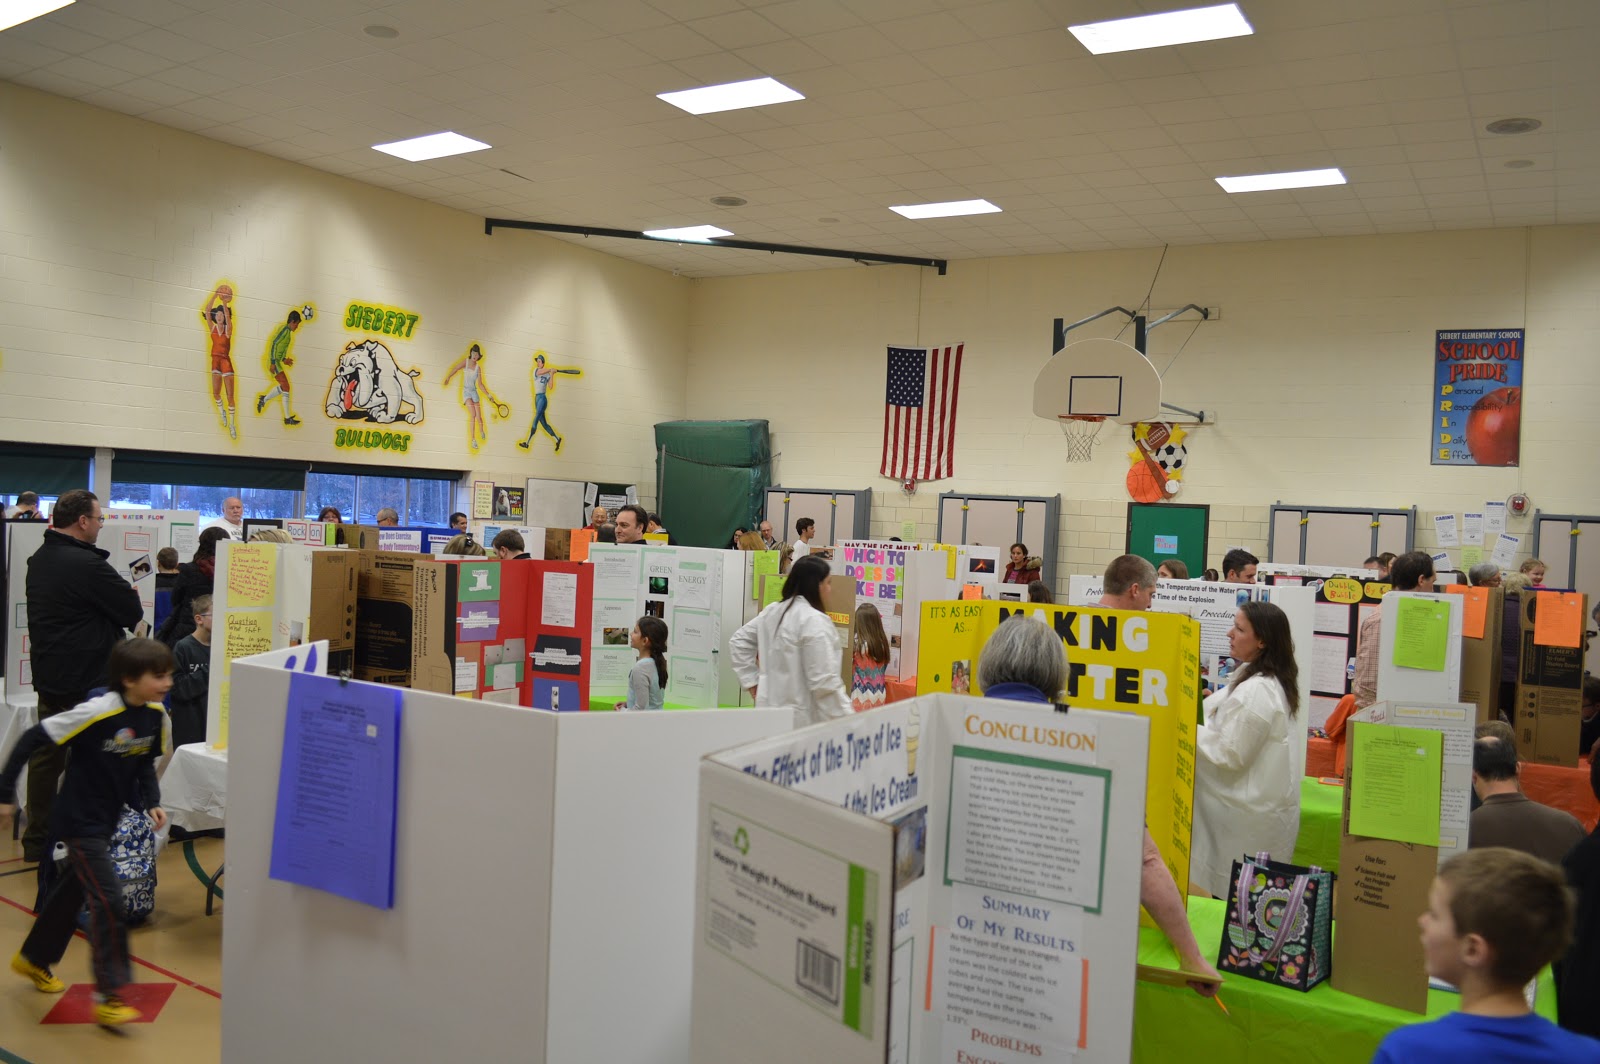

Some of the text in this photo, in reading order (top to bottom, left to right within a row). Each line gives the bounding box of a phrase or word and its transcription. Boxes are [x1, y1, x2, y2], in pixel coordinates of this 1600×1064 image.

[346, 304, 418, 337] SIEBERT
[1440, 332, 1460, 340] SIEBERT
[1498, 331, 1521, 339] SCHOOL
[1439, 340, 1520, 360] SCHOOL
[1448, 363, 1507, 384] PRIDE
[1441, 384, 1484, 396] Personal
[1440, 400, 1502, 412] Responsibility
[1441, 416, 1456, 428] In
[335, 428, 410, 452] BULLDOGS
[1440, 433, 1467, 445] Daily
[1439, 448, 1474, 460] Effort
[288, 526, 320, 537] Rock on
[386, 532, 411, 540] Does Exercise
[384, 543, 392, 551] Body
[393, 543, 419, 551] Temperature?
[844, 548, 905, 566] WHICH TO
[650, 565, 672, 574] GREEN
[846, 565, 903, 582] DOES SH
[678, 575, 707, 584] ENERGY
[856, 581, 875, 597] KE
[1166, 584, 1200, 592] Temperature
[1329, 581, 1356, 591] Dubble
[1366, 585, 1375, 595] By
[1188, 595, 1215, 604] Explosion
[1330, 590, 1356, 600] Bubble
[930, 605, 984, 619] IT'S AS EASY
[228, 615, 257, 627] Question
[965, 714, 1096, 752] CONCLUSION
[771, 750, 807, 786] Effect
[810, 742, 822, 778] of
[826, 739, 842, 773] the
[846, 733, 871, 772] Type
[873, 724, 884, 756] of
[886, 722, 901, 752] Ice
[851, 776, 918, 814] the Ice Cream
[1365, 855, 1375, 863] Use
[1360, 867, 1376, 876] Science
[982, 895, 1050, 922] SUMMARY
[1014, 927, 1076, 953] RESULTS
[963, 948, 1007, 963] temperature
[970, 1028, 1043, 1057] PROBLEMS
